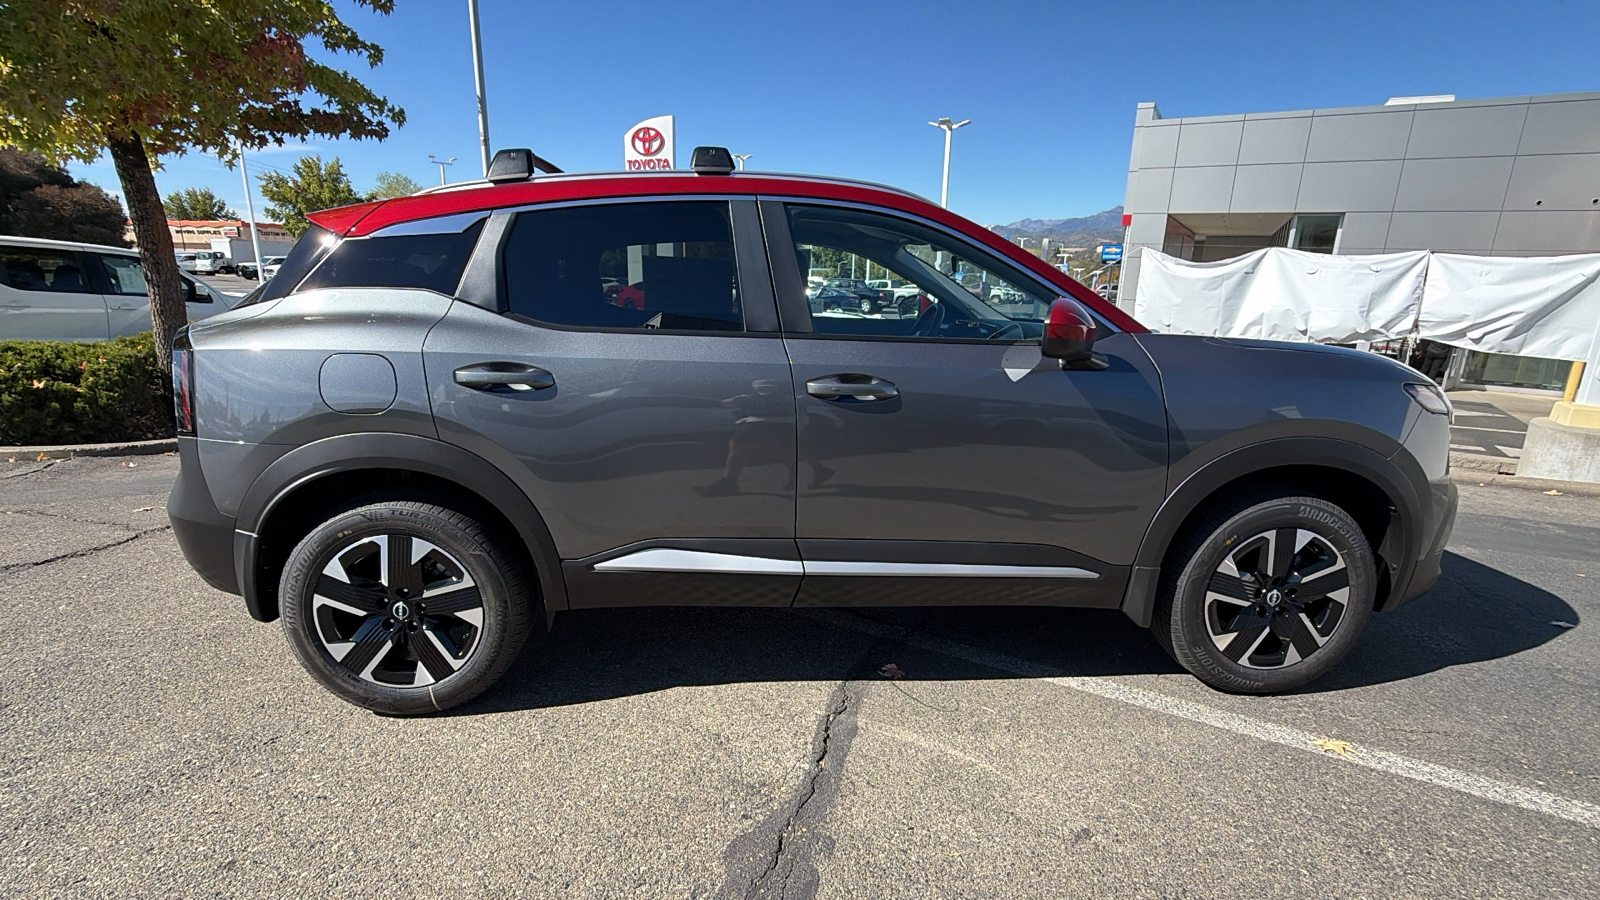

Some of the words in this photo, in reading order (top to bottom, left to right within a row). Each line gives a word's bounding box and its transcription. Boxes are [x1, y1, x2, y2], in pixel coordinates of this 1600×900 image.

[626, 158, 672, 171] TOYOTA
[1297, 504, 1365, 557] BRIDGESTONE
[286, 540, 322, 630] BRIDGESTONE
[1191, 645, 1265, 689] BRIDGESTONE
